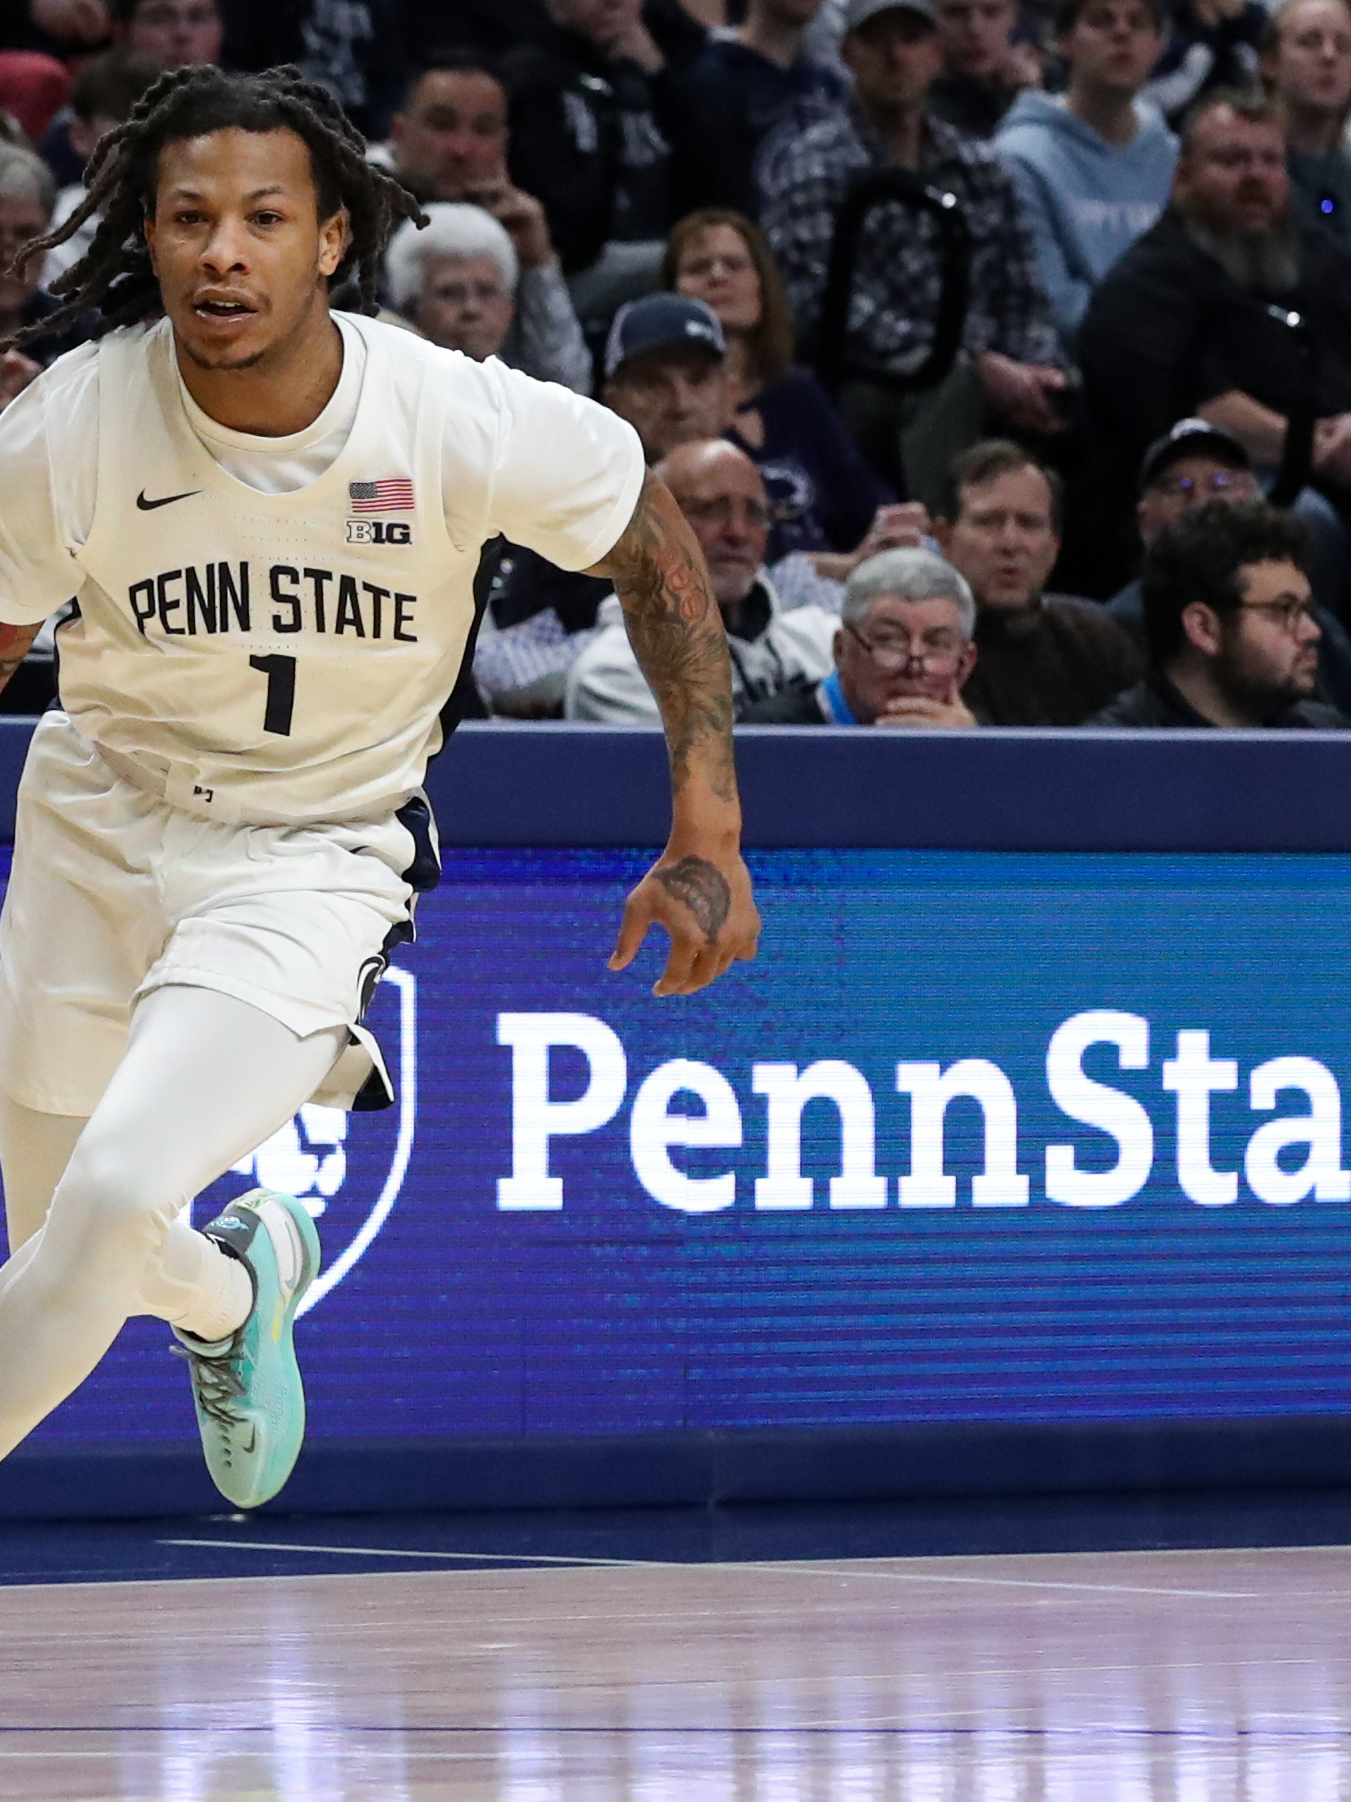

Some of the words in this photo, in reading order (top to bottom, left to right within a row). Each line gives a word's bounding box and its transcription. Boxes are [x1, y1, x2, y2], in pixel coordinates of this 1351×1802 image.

[128, 560, 251, 636] PENN
[269, 564, 418, 642] STATE
[249, 653, 297, 737] 1
[495, 1008, 1351, 1212] PennSta
